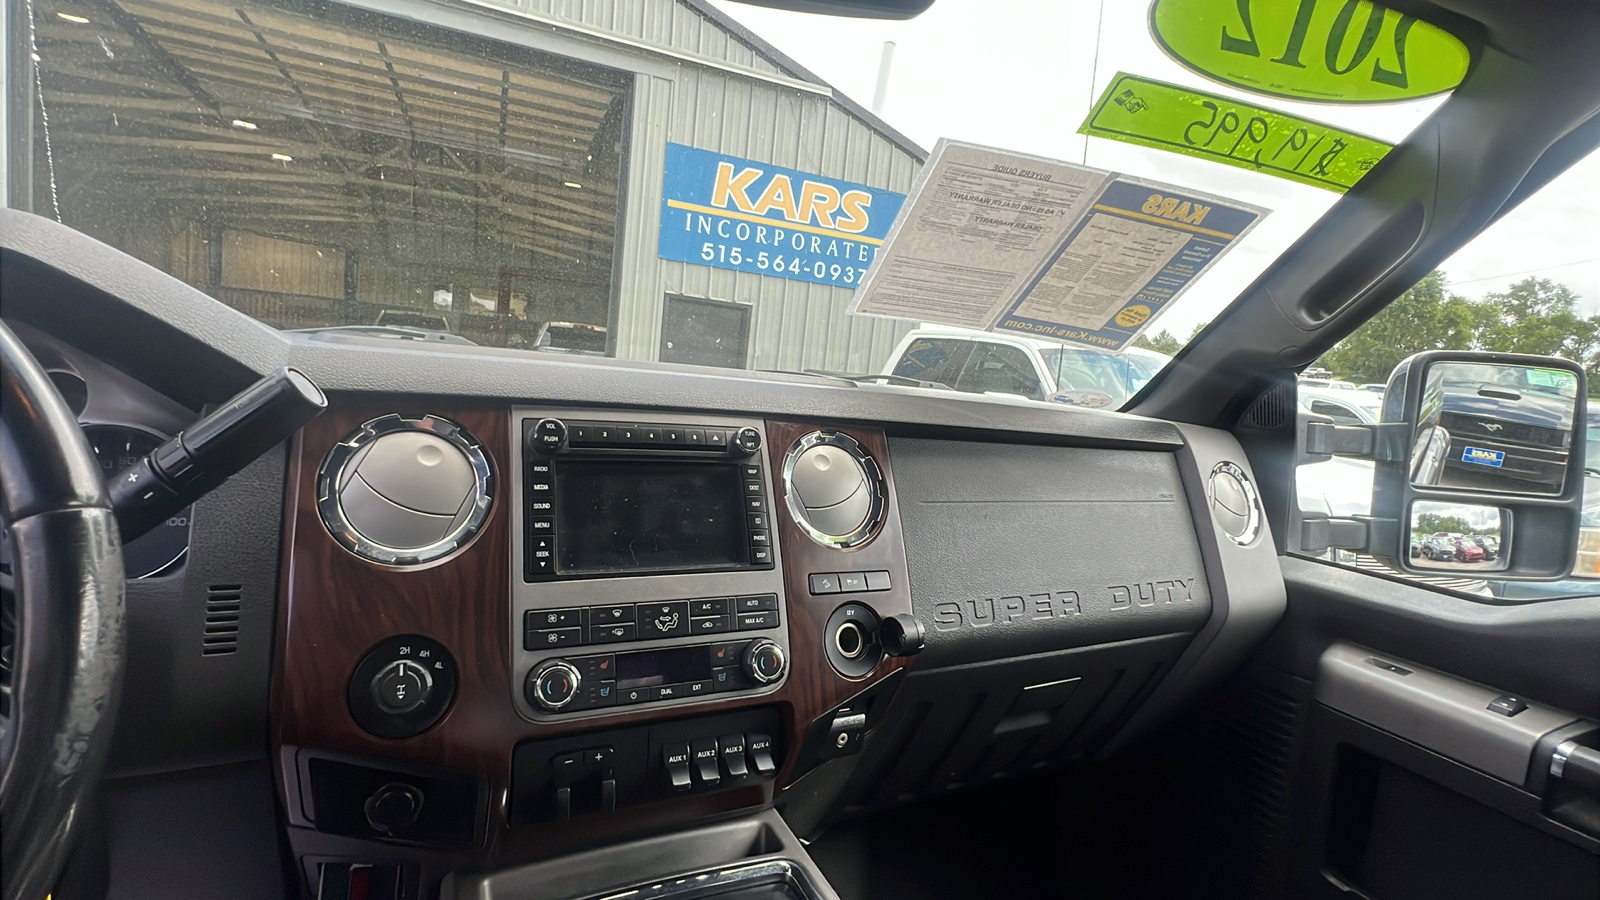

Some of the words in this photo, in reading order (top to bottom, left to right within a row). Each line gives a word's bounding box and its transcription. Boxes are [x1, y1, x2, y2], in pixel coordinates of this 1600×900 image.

[711, 161, 872, 233] KARS
[701, 242, 867, 285] 515-564-0937
[533, 502, 551, 510] SOUND
[534, 521, 550, 529] MENU
[934, 590, 1081, 632] SUPER
[1107, 578, 1194, 611] DUTY
[400, 646, 411, 655] 2H
[434, 661, 444, 669] 4L
[668, 755, 681, 763] AUX
